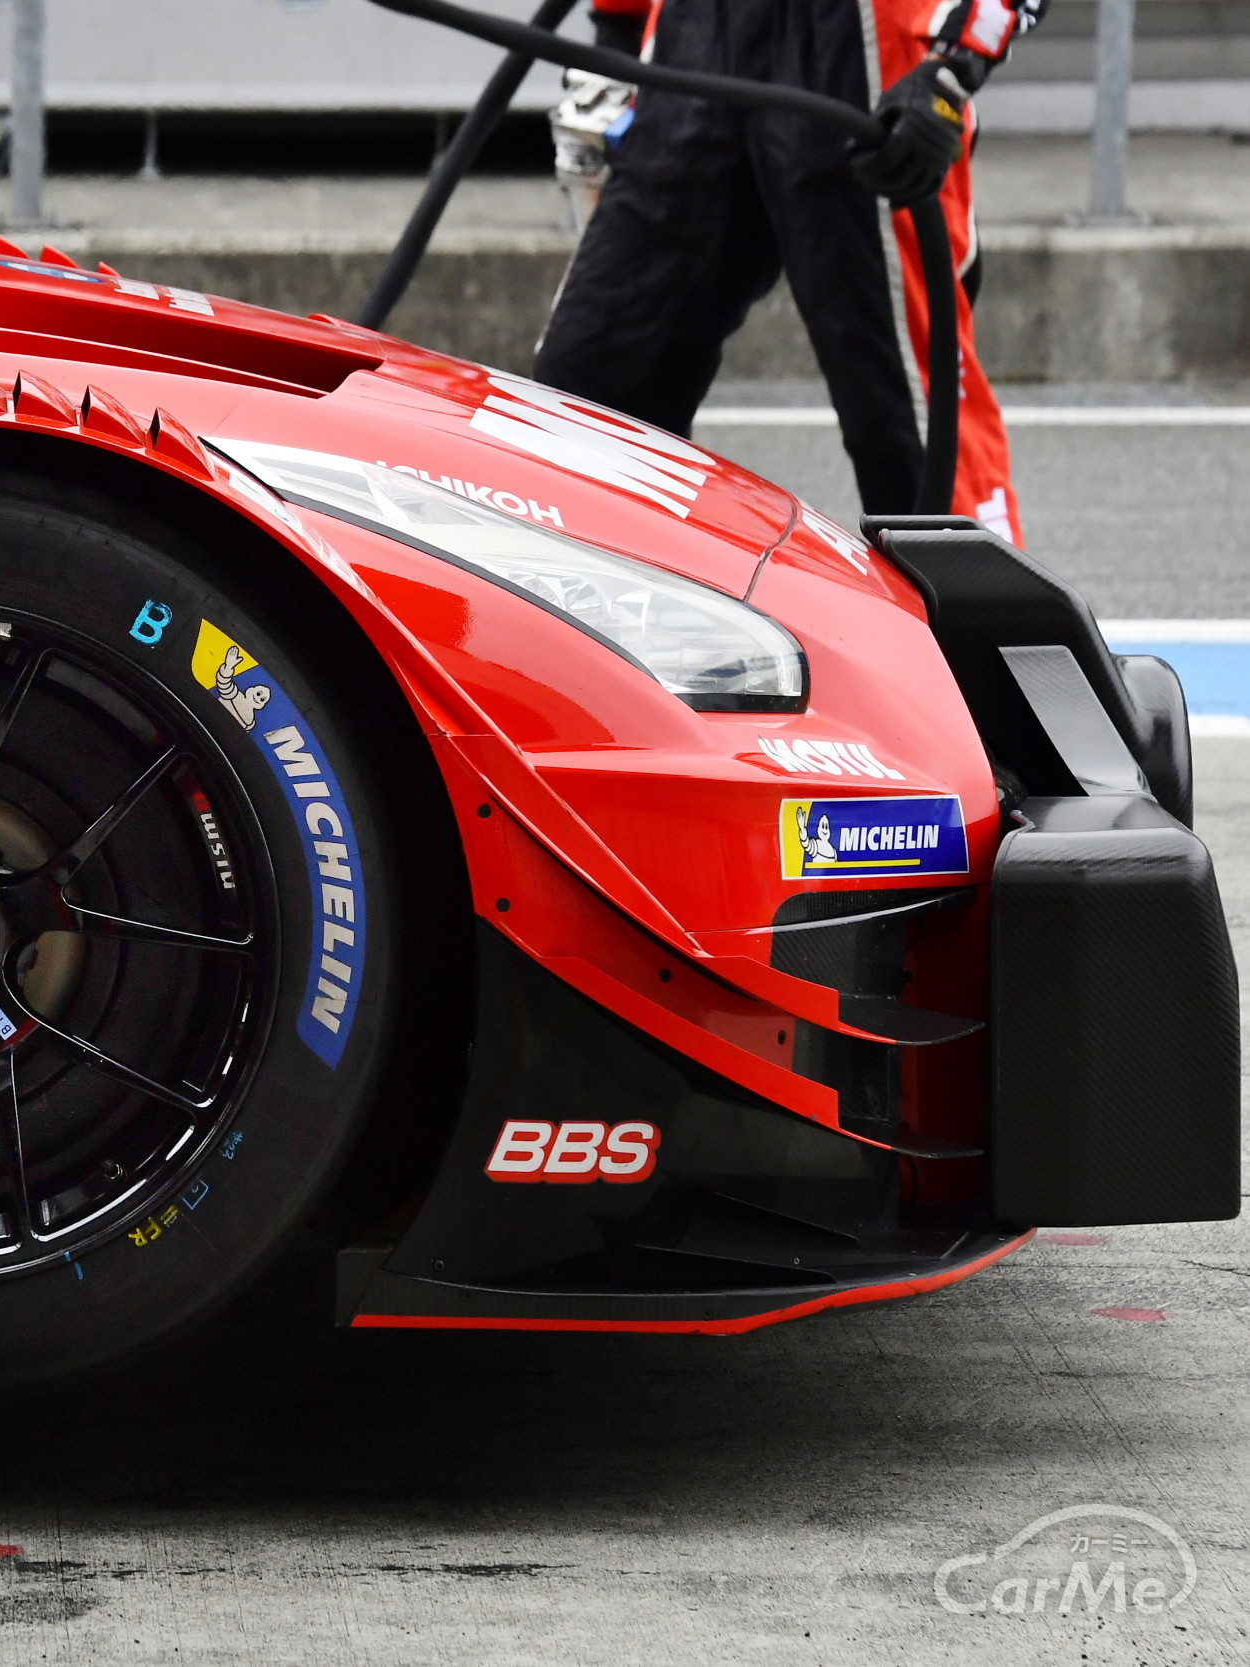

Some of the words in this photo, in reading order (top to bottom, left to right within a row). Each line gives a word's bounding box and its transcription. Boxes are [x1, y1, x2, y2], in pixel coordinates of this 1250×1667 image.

[375, 460, 565, 528] HIKOH
[129, 600, 173, 645] B
[757, 737, 907, 781] MOTUL
[839, 824, 940, 852] MICHELIN
[264, 725, 356, 1035] MICHELIN
[485, 1120, 662, 1184] BBS
